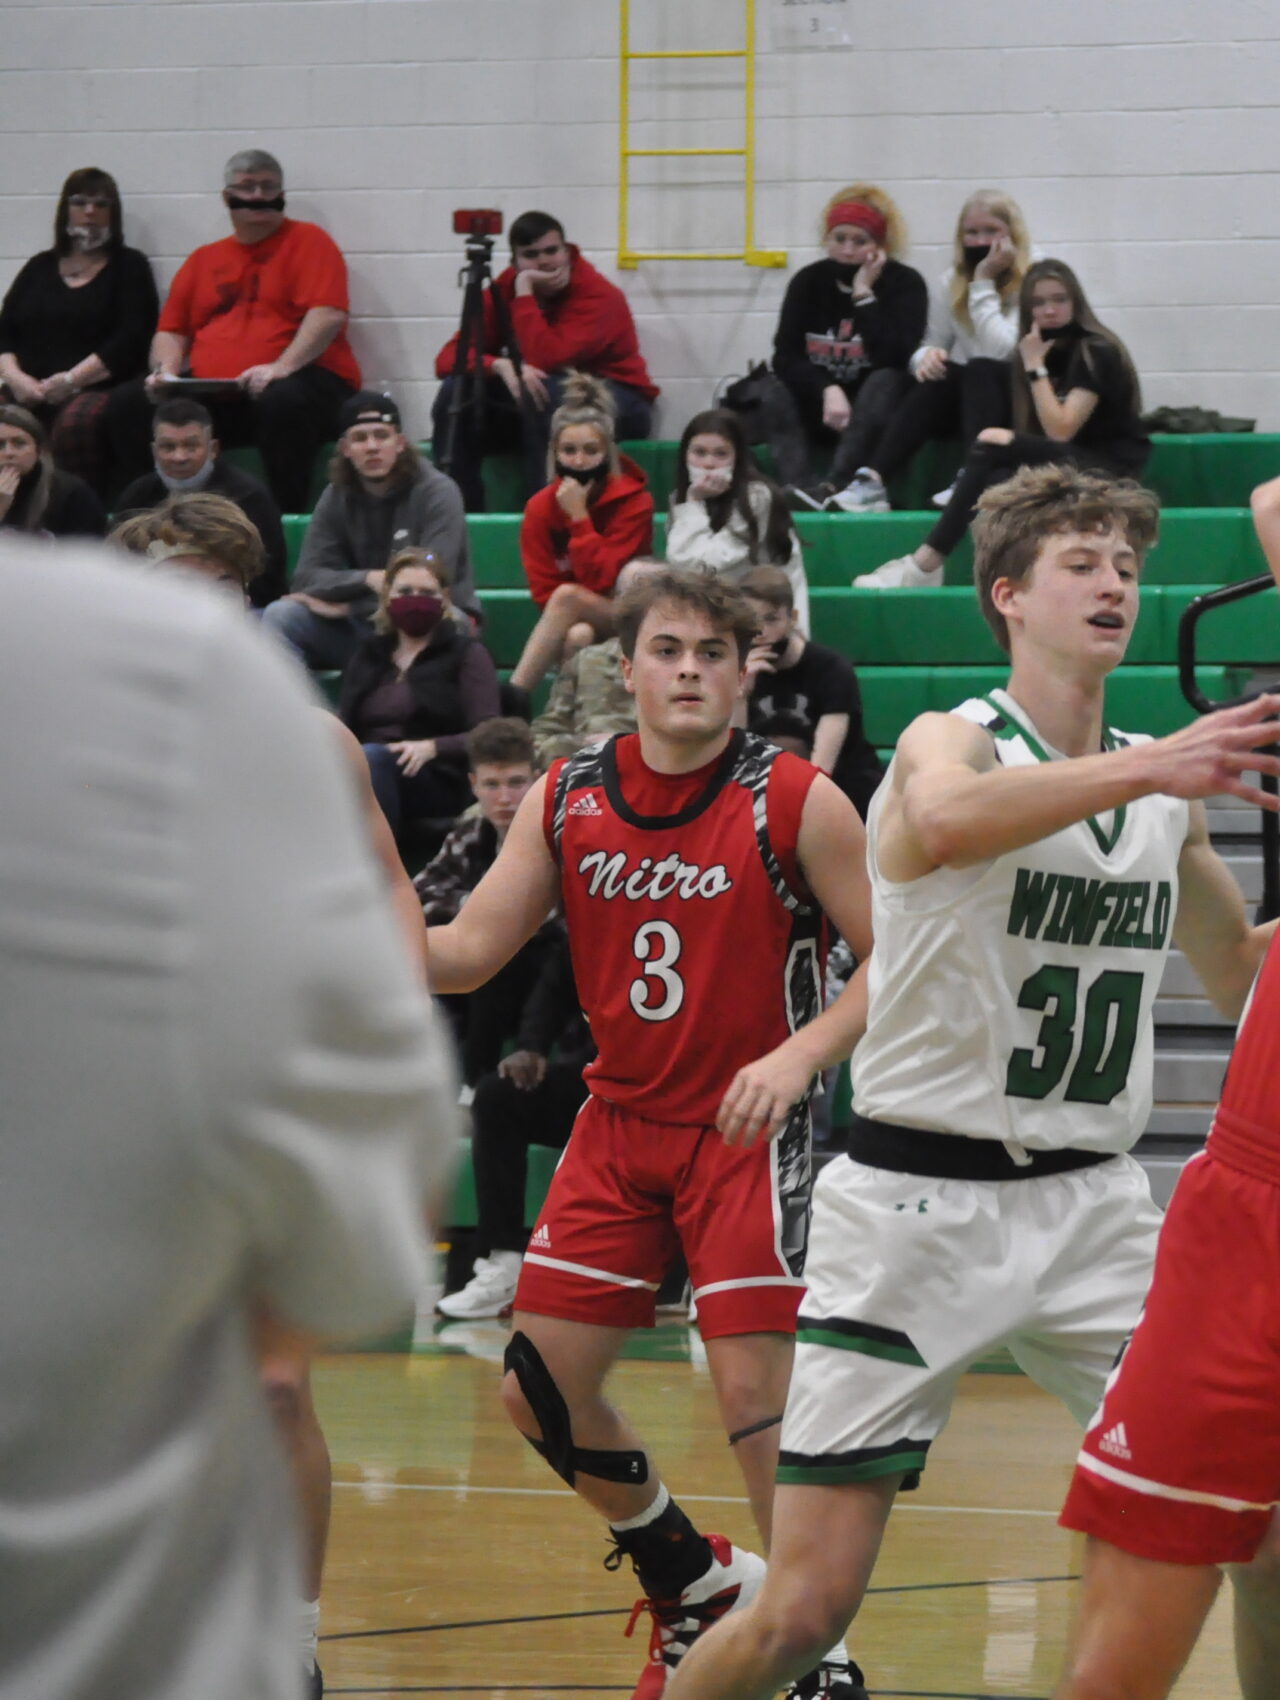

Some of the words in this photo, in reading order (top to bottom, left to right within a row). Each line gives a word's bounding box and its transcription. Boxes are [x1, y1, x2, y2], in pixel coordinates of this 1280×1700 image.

[568, 807, 602, 816] adidas
[578, 850, 733, 900] Nitro
[1006, 867, 1172, 950] WINFIELD
[629, 918, 685, 1022] 3
[1004, 964, 1145, 1106] 30
